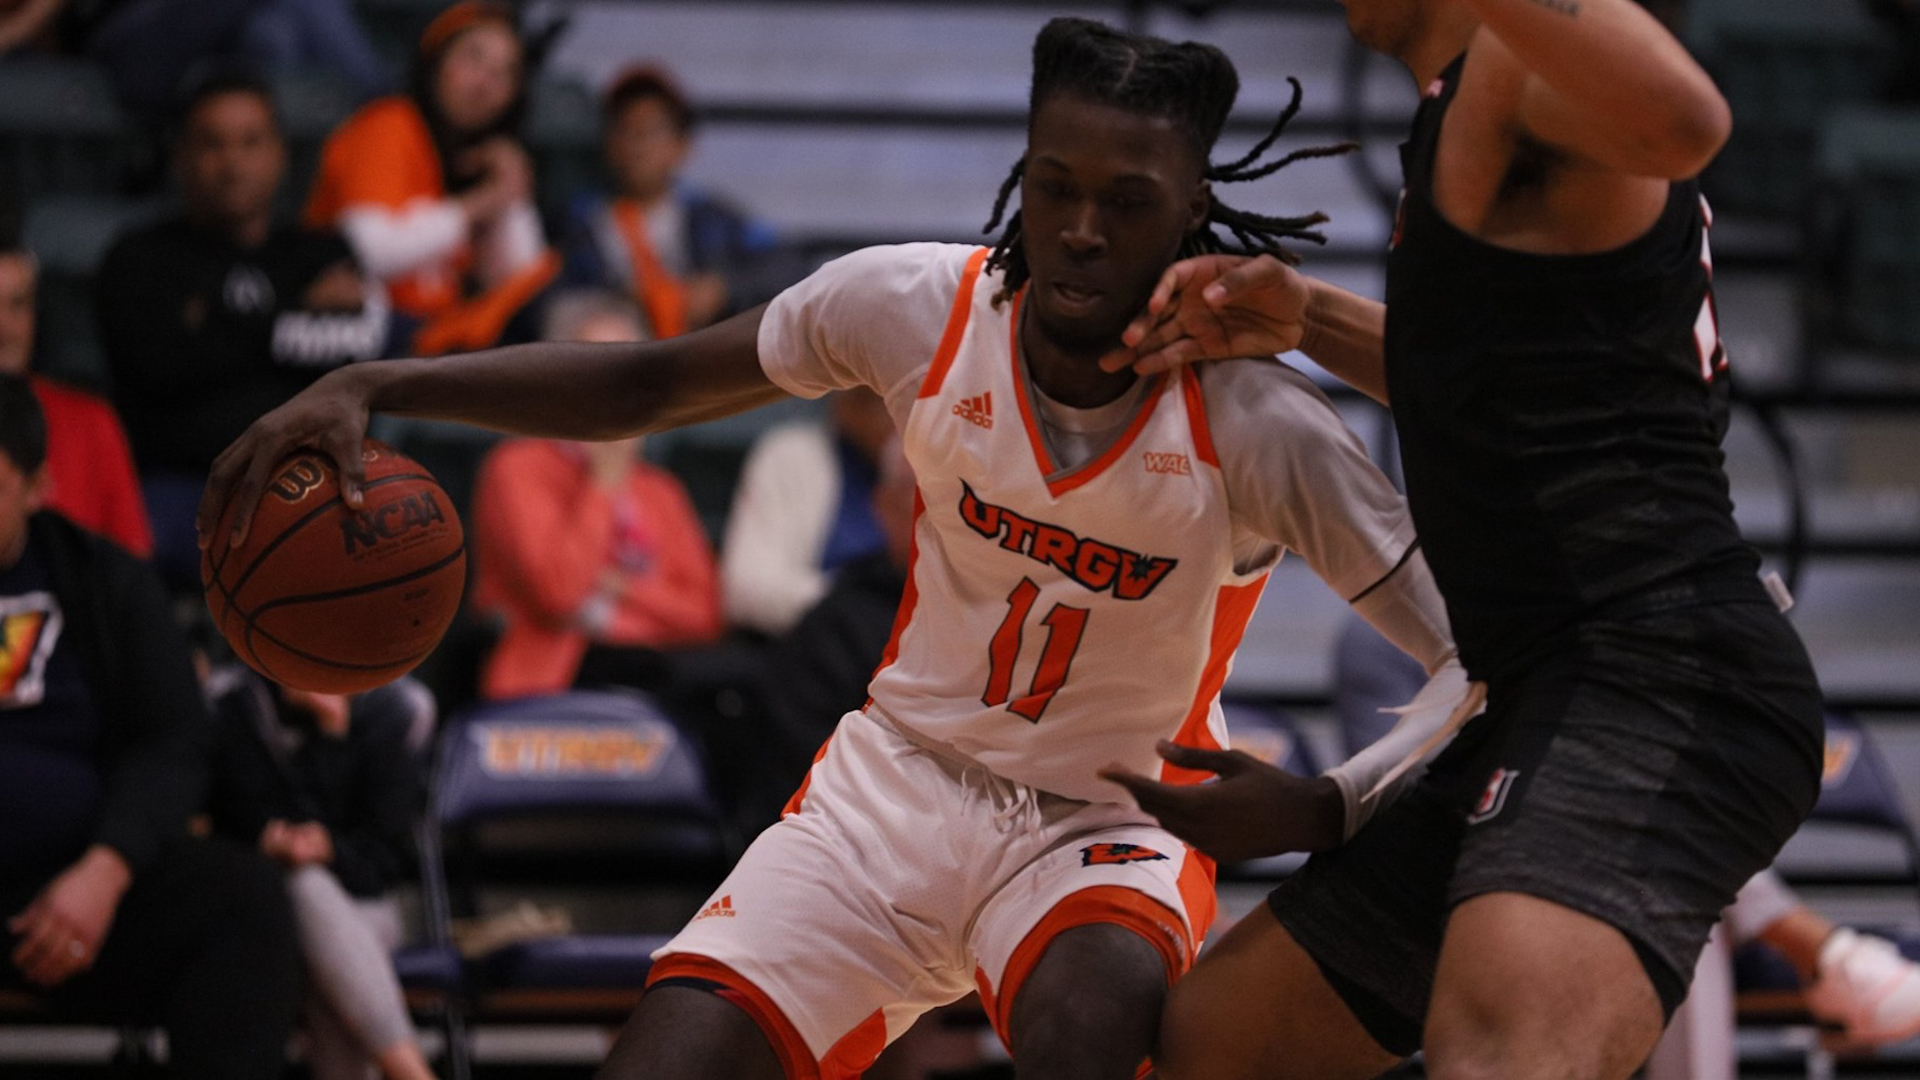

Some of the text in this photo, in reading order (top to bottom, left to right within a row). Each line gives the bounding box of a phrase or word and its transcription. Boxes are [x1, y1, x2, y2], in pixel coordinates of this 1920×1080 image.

[952, 404, 994, 430] adida
[341, 491, 445, 555] NCAA
[957, 477, 1178, 600] UTRGV
[980, 576, 1091, 724] 11
